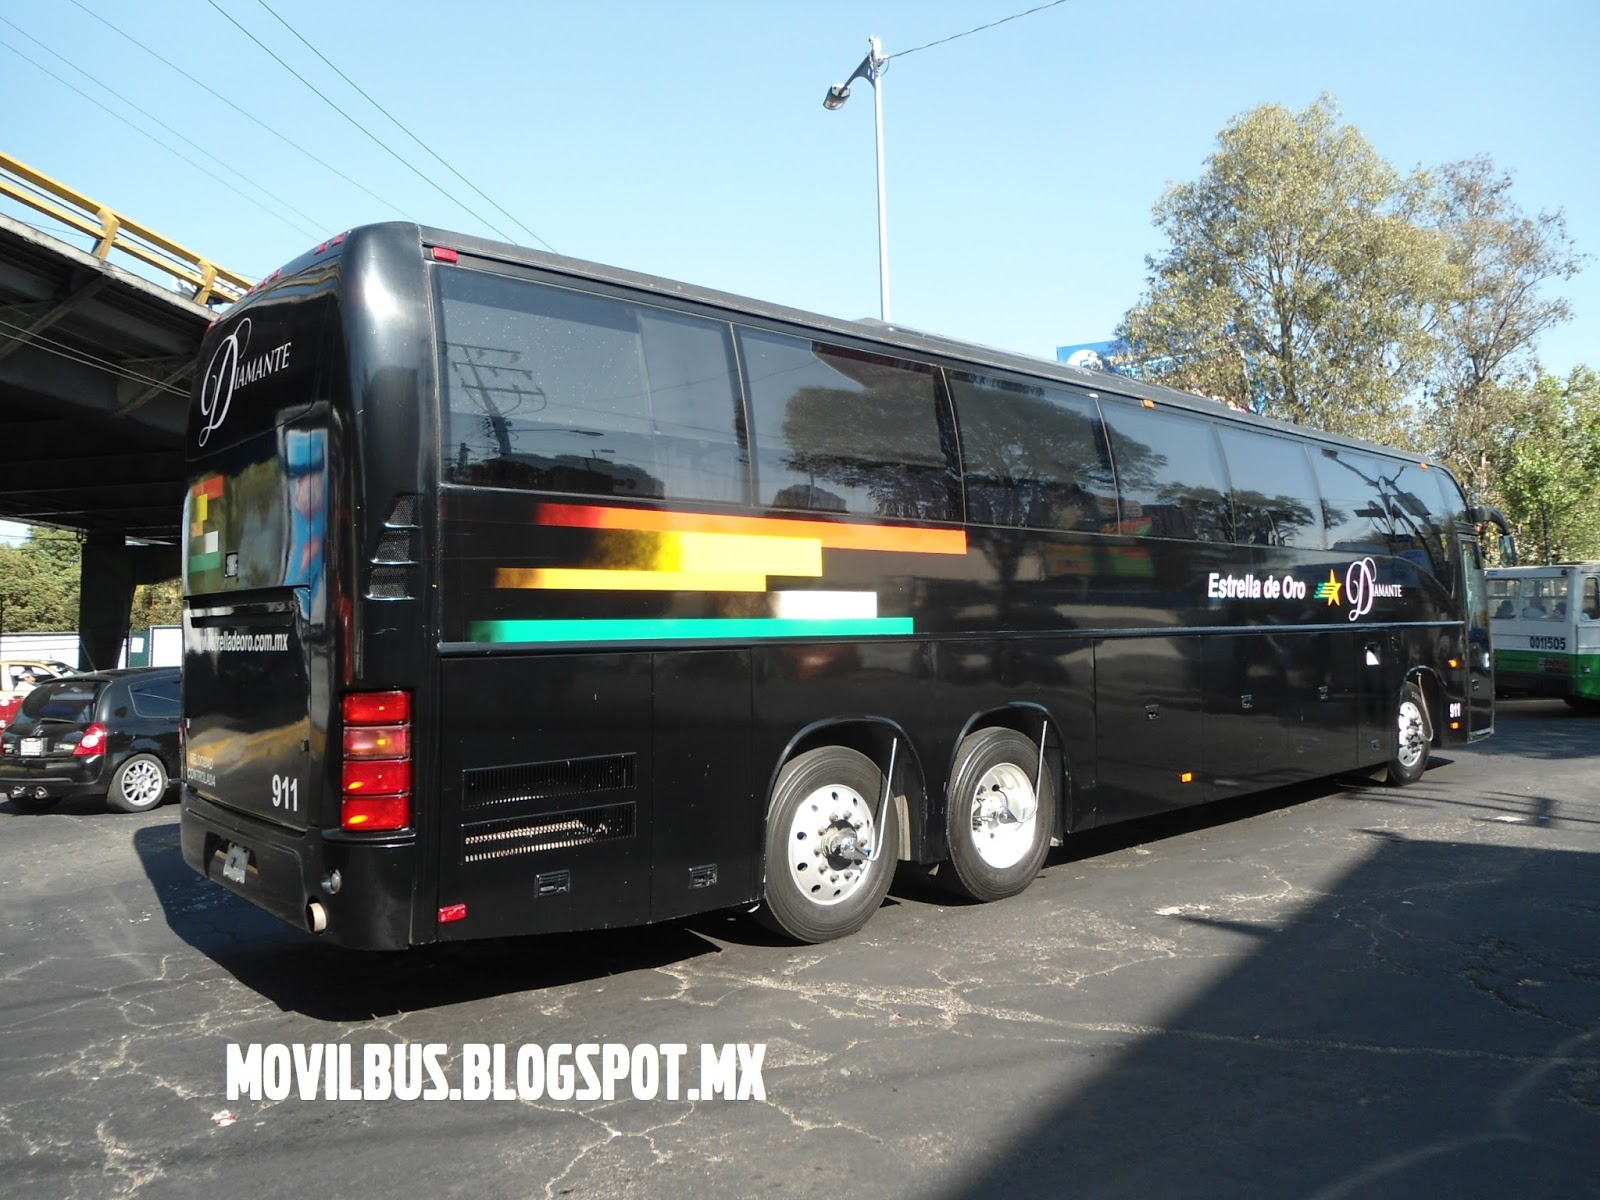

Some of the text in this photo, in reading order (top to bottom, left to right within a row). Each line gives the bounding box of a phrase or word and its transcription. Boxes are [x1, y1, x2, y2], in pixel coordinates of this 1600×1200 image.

[199, 317, 292, 447] DIAMANTE
[1208, 573, 1306, 599] Estrella de Oro
[1346, 556, 1403, 622] DIAMANTE
[194, 630, 289, 652] .trelladeoro.com.mx
[1529, 635, 1567, 651] 0011505
[1449, 703, 1461, 718] 911
[271, 773, 298, 812] 911
